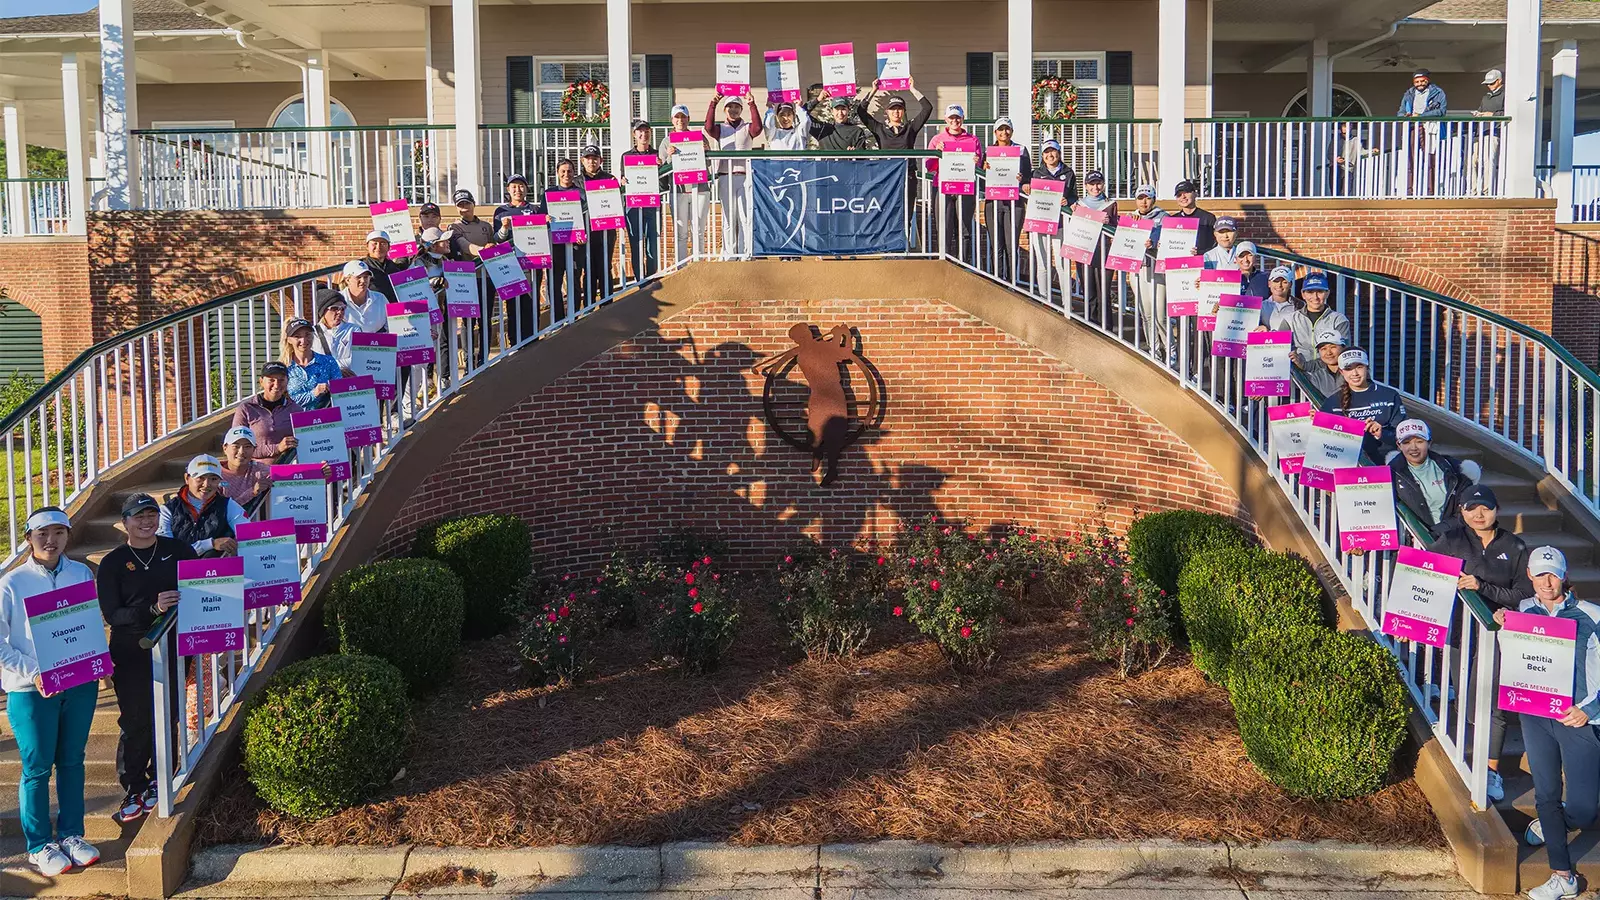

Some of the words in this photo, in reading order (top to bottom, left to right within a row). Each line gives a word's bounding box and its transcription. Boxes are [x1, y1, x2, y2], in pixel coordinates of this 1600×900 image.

[816, 197, 882, 214] LPGA
[310, 445, 334, 453] Hartlage
[1323, 443, 1344, 453] Yealimi
[1422, 562, 1434, 570] AA
[1412, 585, 1434, 596] Robyn
[201, 595, 222, 603] Malia
[1413, 594, 1429, 604] Choi
[56, 599, 69, 609] AA
[1413, 613, 1437, 623] MEMBER
[51, 624, 85, 639] Xiaowen
[1532, 626, 1546, 634] AA
[53, 659, 69, 667] LPGA
[69, 650, 96, 663] MEMBER
[1522, 653, 1552, 663] Laetitia
[91, 659, 102, 668] 20
[1527, 663, 1546, 672] Beck
[92, 667, 104, 675] 24
[1530, 684, 1558, 693] MEMBER
[1550, 698, 1562, 706] 20
[1550, 705, 1561, 714] 24
